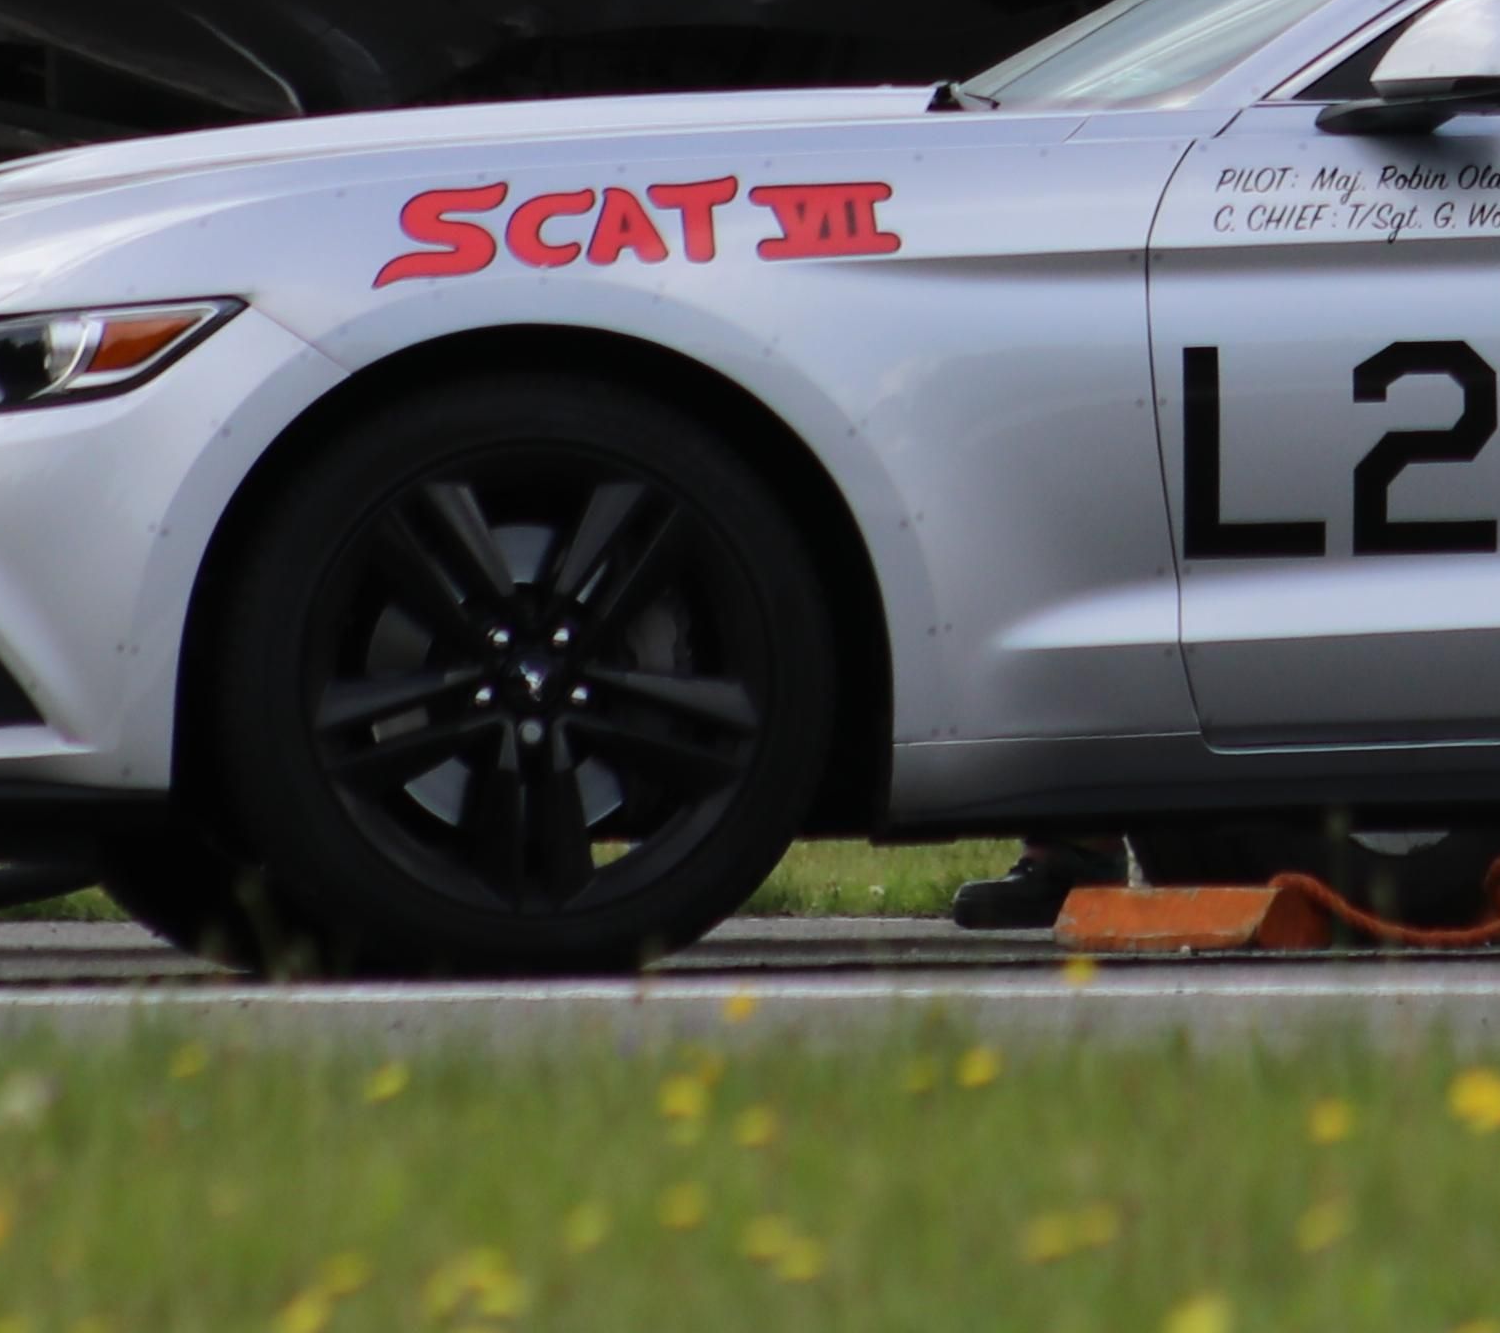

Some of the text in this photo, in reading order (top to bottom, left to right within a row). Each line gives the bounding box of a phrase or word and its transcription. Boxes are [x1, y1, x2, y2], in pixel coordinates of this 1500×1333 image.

[1213, 205, 1236, 232] C.
[1348, 202, 1422, 244] T/Sgt.
[1433, 202, 1456, 230] G.
[1215, 167, 1299, 193] PILOT:
[1310, 166, 1366, 205] Maj.
[1376, 164, 1449, 191] Robin
[372, 176, 902, 289] SCAT VII
[1182, 340, 1498, 560] L2
